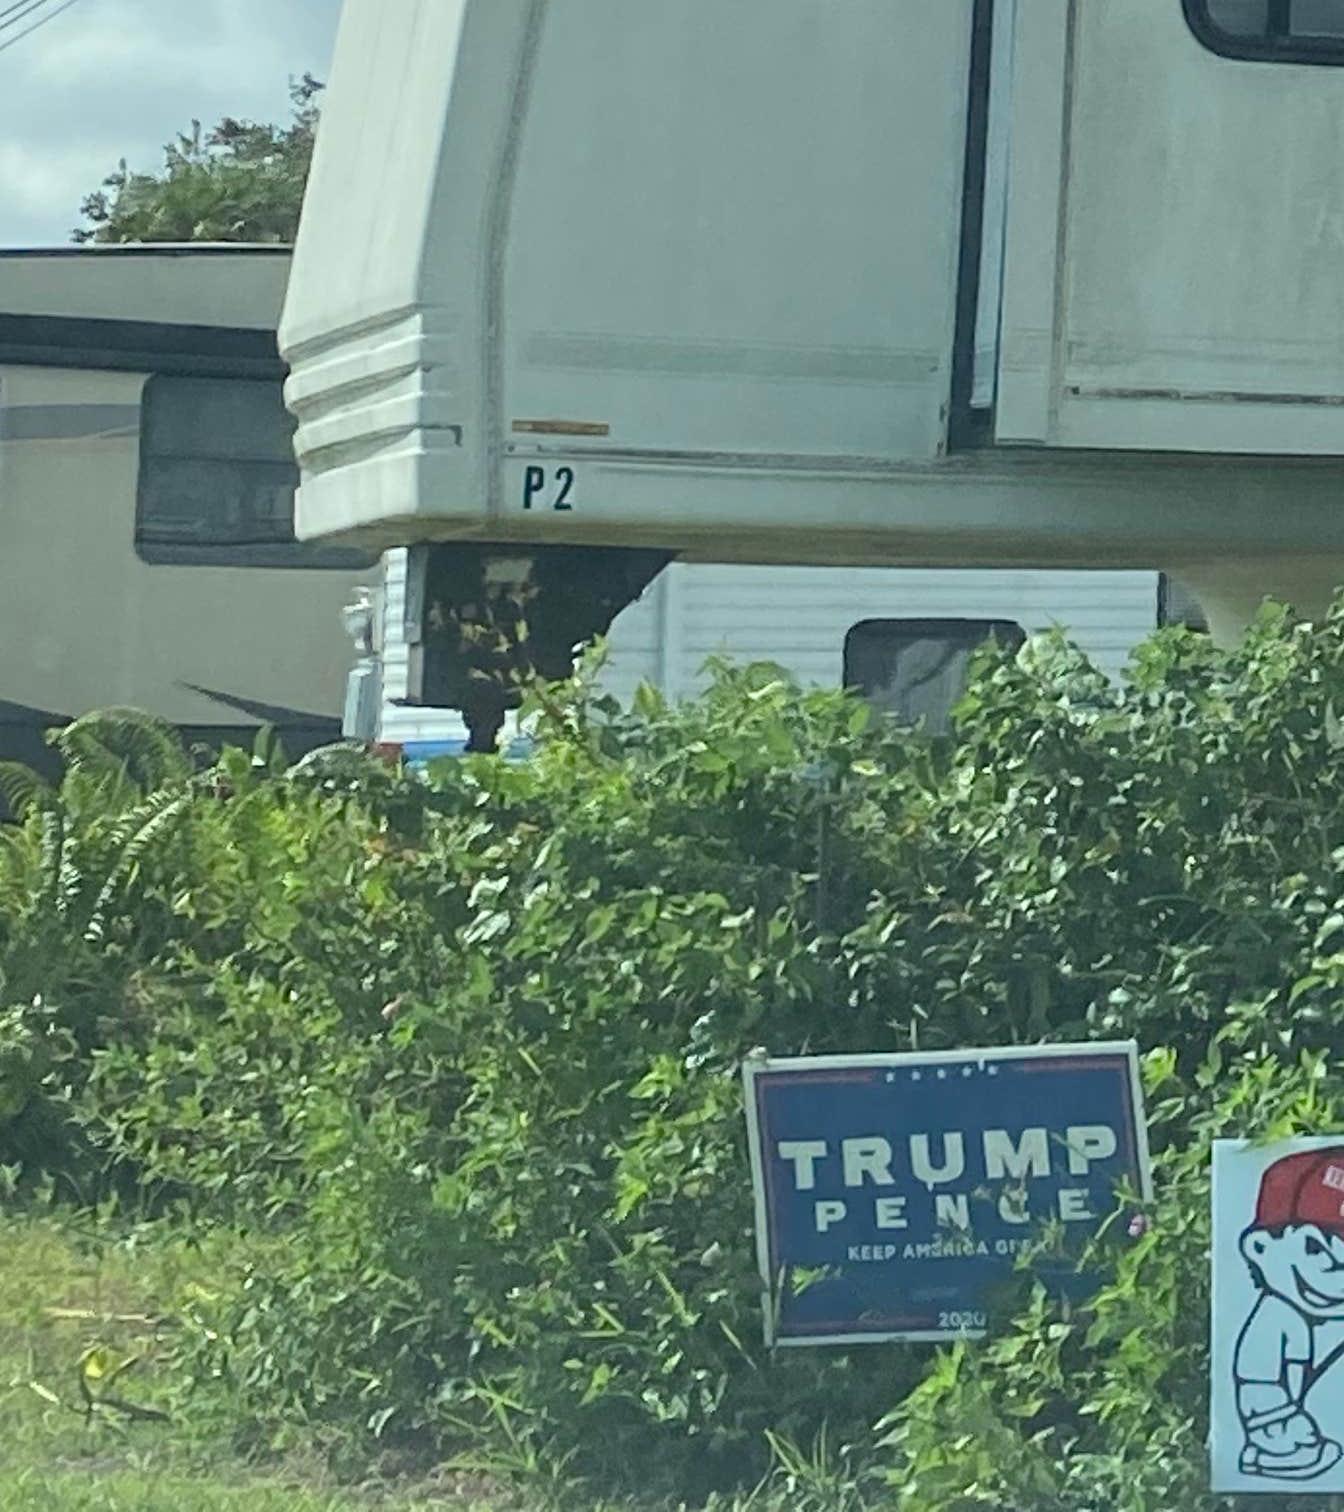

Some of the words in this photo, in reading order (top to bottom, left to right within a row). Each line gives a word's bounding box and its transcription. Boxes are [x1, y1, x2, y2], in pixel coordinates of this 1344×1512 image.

[777, 1124, 1118, 1190] TRUMP
[813, 1188, 1096, 1233] PENCE
[847, 1244, 896, 1261] KEEP
[938, 1310, 987, 1328] 2020
